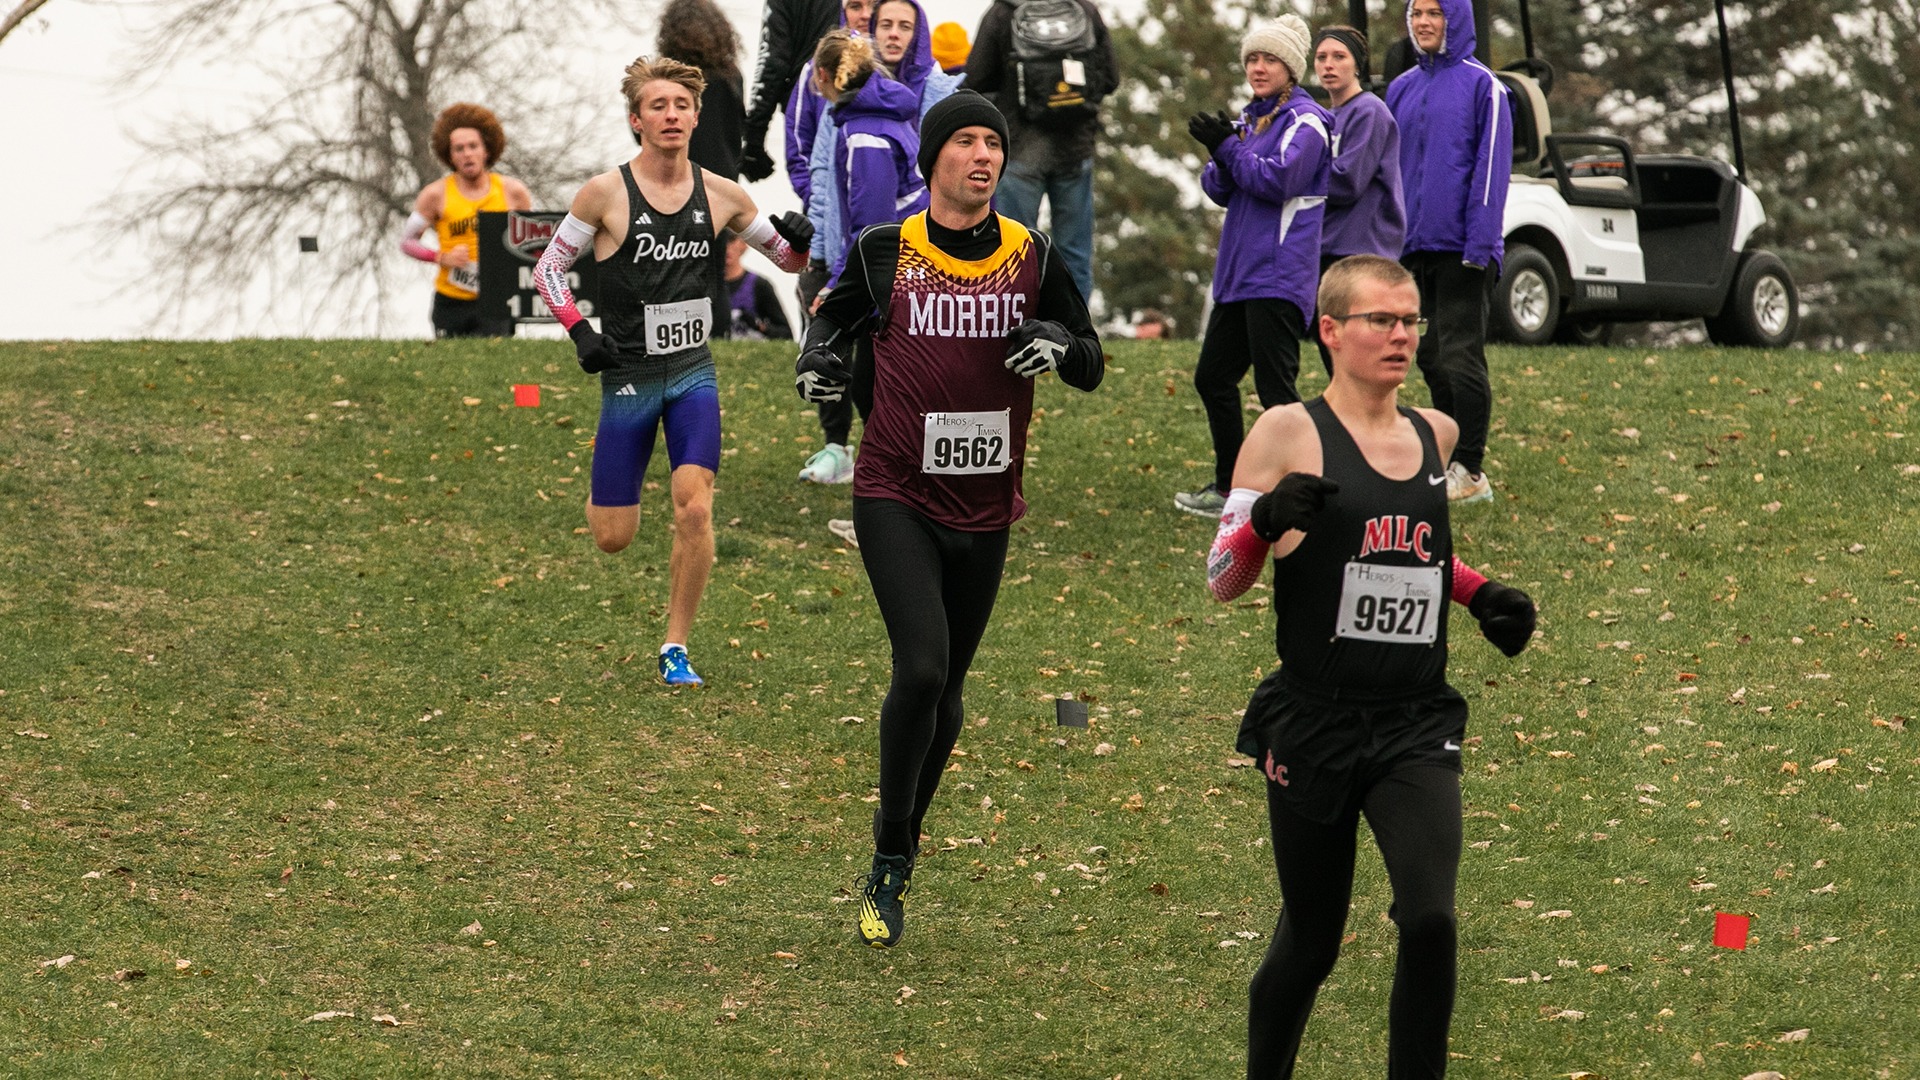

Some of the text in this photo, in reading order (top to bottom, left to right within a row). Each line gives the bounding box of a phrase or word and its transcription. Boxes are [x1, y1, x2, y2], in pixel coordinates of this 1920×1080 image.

[1602, 218, 1615, 233] 34
[633, 232, 709, 263] Polars
[518, 266, 581, 290] Mn
[506, 295, 521, 318] 1
[908, 292, 1026, 337] MORRIS
[656, 318, 704, 349] 9518
[975, 423, 1003, 436] TIMING
[934, 436, 1003, 468] 9562
[1360, 515, 1432, 562] MLC
[1354, 595, 1430, 635] 9527
[1265, 748, 1290, 787] LC
